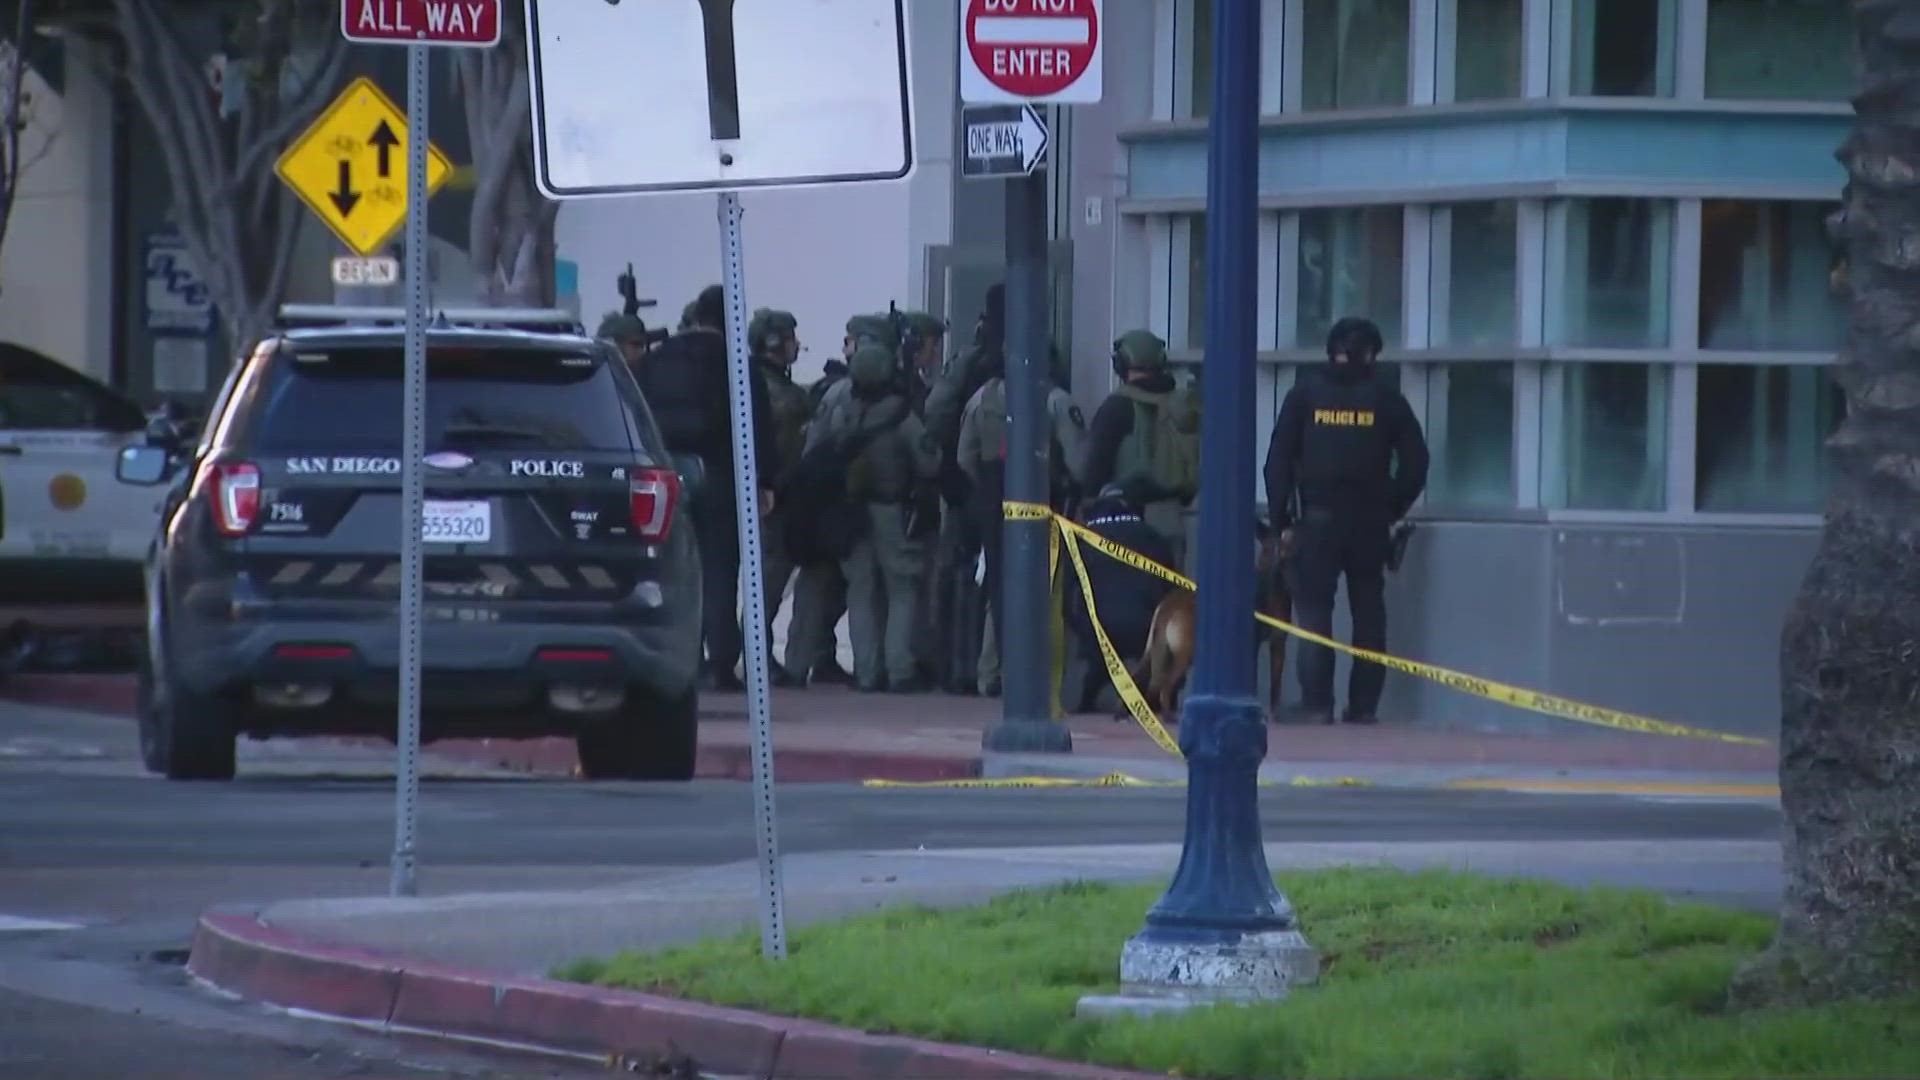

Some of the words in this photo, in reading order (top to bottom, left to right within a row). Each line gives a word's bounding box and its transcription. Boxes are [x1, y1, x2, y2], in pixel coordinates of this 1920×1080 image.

[358, 0, 412, 31] ALL
[425, 1, 485, 36] WAY
[993, 48, 1071, 76] ENTER
[970, 127, 992, 154] ONE
[994, 124, 1020, 154] WAY
[339, 261, 390, 281] BEGIN
[1313, 409, 1355, 426] POLICE
[286, 457, 328, 474] SAN
[332, 457, 401, 474] DIEGO
[510, 459, 585, 478] POLICE
[1099, 538, 1139, 566] POLICE
